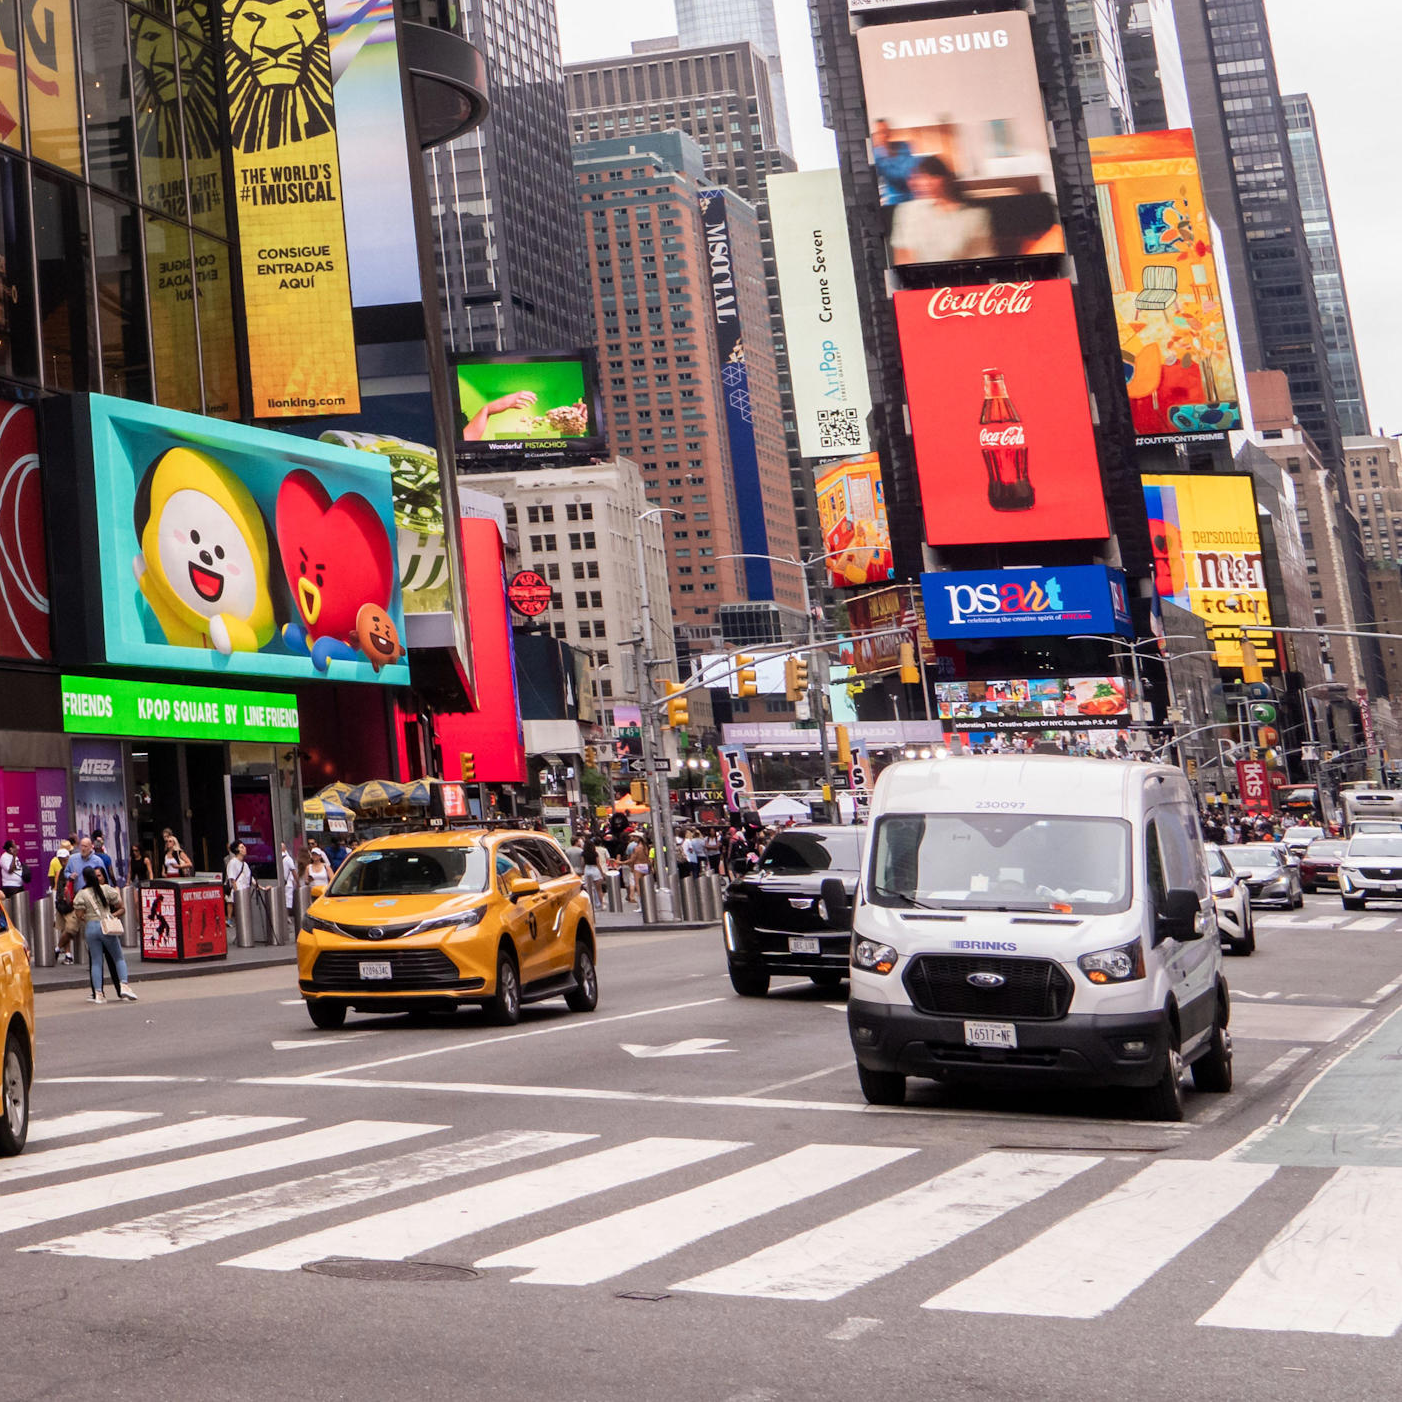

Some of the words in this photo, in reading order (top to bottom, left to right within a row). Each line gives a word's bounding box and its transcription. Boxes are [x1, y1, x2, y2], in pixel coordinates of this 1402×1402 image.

[881, 29, 1009, 60] SAMSUNG
[241, 169, 268, 185] THE
[269, 163, 332, 183] WORLD'S
[260, 181, 337, 205] MUSICAL
[257, 244, 331, 261] CONSIGUE
[812, 229, 827, 274] Seven
[256, 259, 334, 276] ENTRADAS
[278, 272, 315, 291] AQUÍ
[818, 276, 833, 323] Crane
[927, 281, 1035, 320] Coca-Cola
[819, 340, 839, 400] ArtPop
[266, 394, 347, 409] lionking.com
[979, 425, 1025, 446] Coca-Cola
[1136, 432, 1225, 446] #OUTFRONTPRIME
[488, 442, 523, 450] Wonderful
[525, 440, 568, 449] PISTACHIOS
[944, 576, 1064, 625] psart
[63, 691, 113, 718] FRIENDS
[138, 697, 171, 722] KPOP
[173, 700, 220, 724] SQUARE
[224, 706, 238, 724] BY
[243, 706, 265, 728] LINE
[626, 728, 634, 736] 45
[956, 722, 985, 730] elebrating
[1023, 720, 1040, 728] Spirit
[1050, 719, 1063, 727] NYC
[79, 758, 115, 775] ATEEZ
[1244, 762, 1262, 797] tkts
[685, 791, 725, 801] KLIKTIX
[975, 801, 1026, 810] 230097
[959, 940, 1018, 951] BRINKS
[969, 1027, 995, 1041] 16517
[1000, 1029, 1012, 1042] NF
